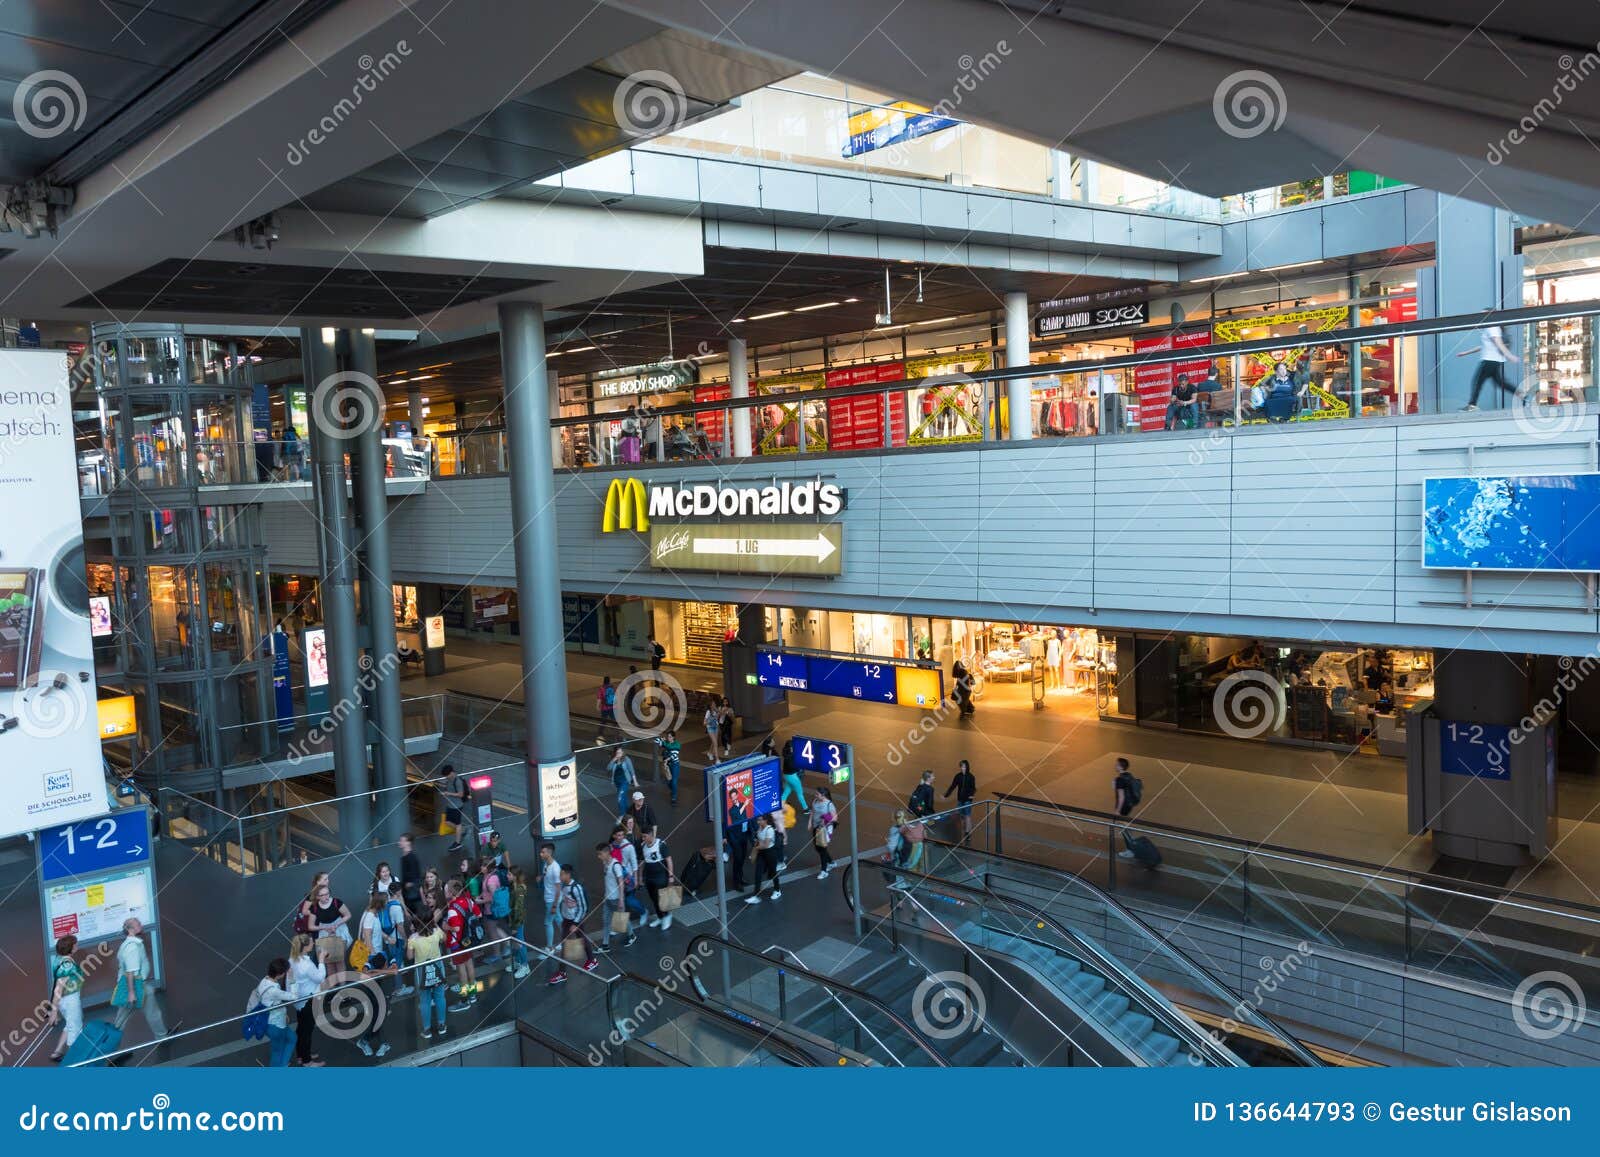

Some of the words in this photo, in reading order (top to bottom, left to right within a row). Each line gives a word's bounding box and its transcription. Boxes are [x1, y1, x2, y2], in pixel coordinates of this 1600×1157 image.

[1040, 314, 1063, 332] CAMP
[1065, 311, 1090, 328] DAVID
[600, 383, 618, 397] THE
[620, 379, 646, 394] BODY
[648, 374, 676, 391] SHOP
[0, 391, 56, 406] ema
[648, 481, 842, 517] McDonald's
[745, 540, 759, 554] UG
[767, 654, 783, 667] 1-4
[863, 665, 881, 679] 1-2
[1447, 722, 1485, 745] 1-2
[801, 740, 814, 764] 4
[828, 744, 841, 769] 3
[27, 803, 39, 811] DIE
[41, 792, 92, 808] SCHOKOLADE
[59, 818, 119, 855] 1-2
